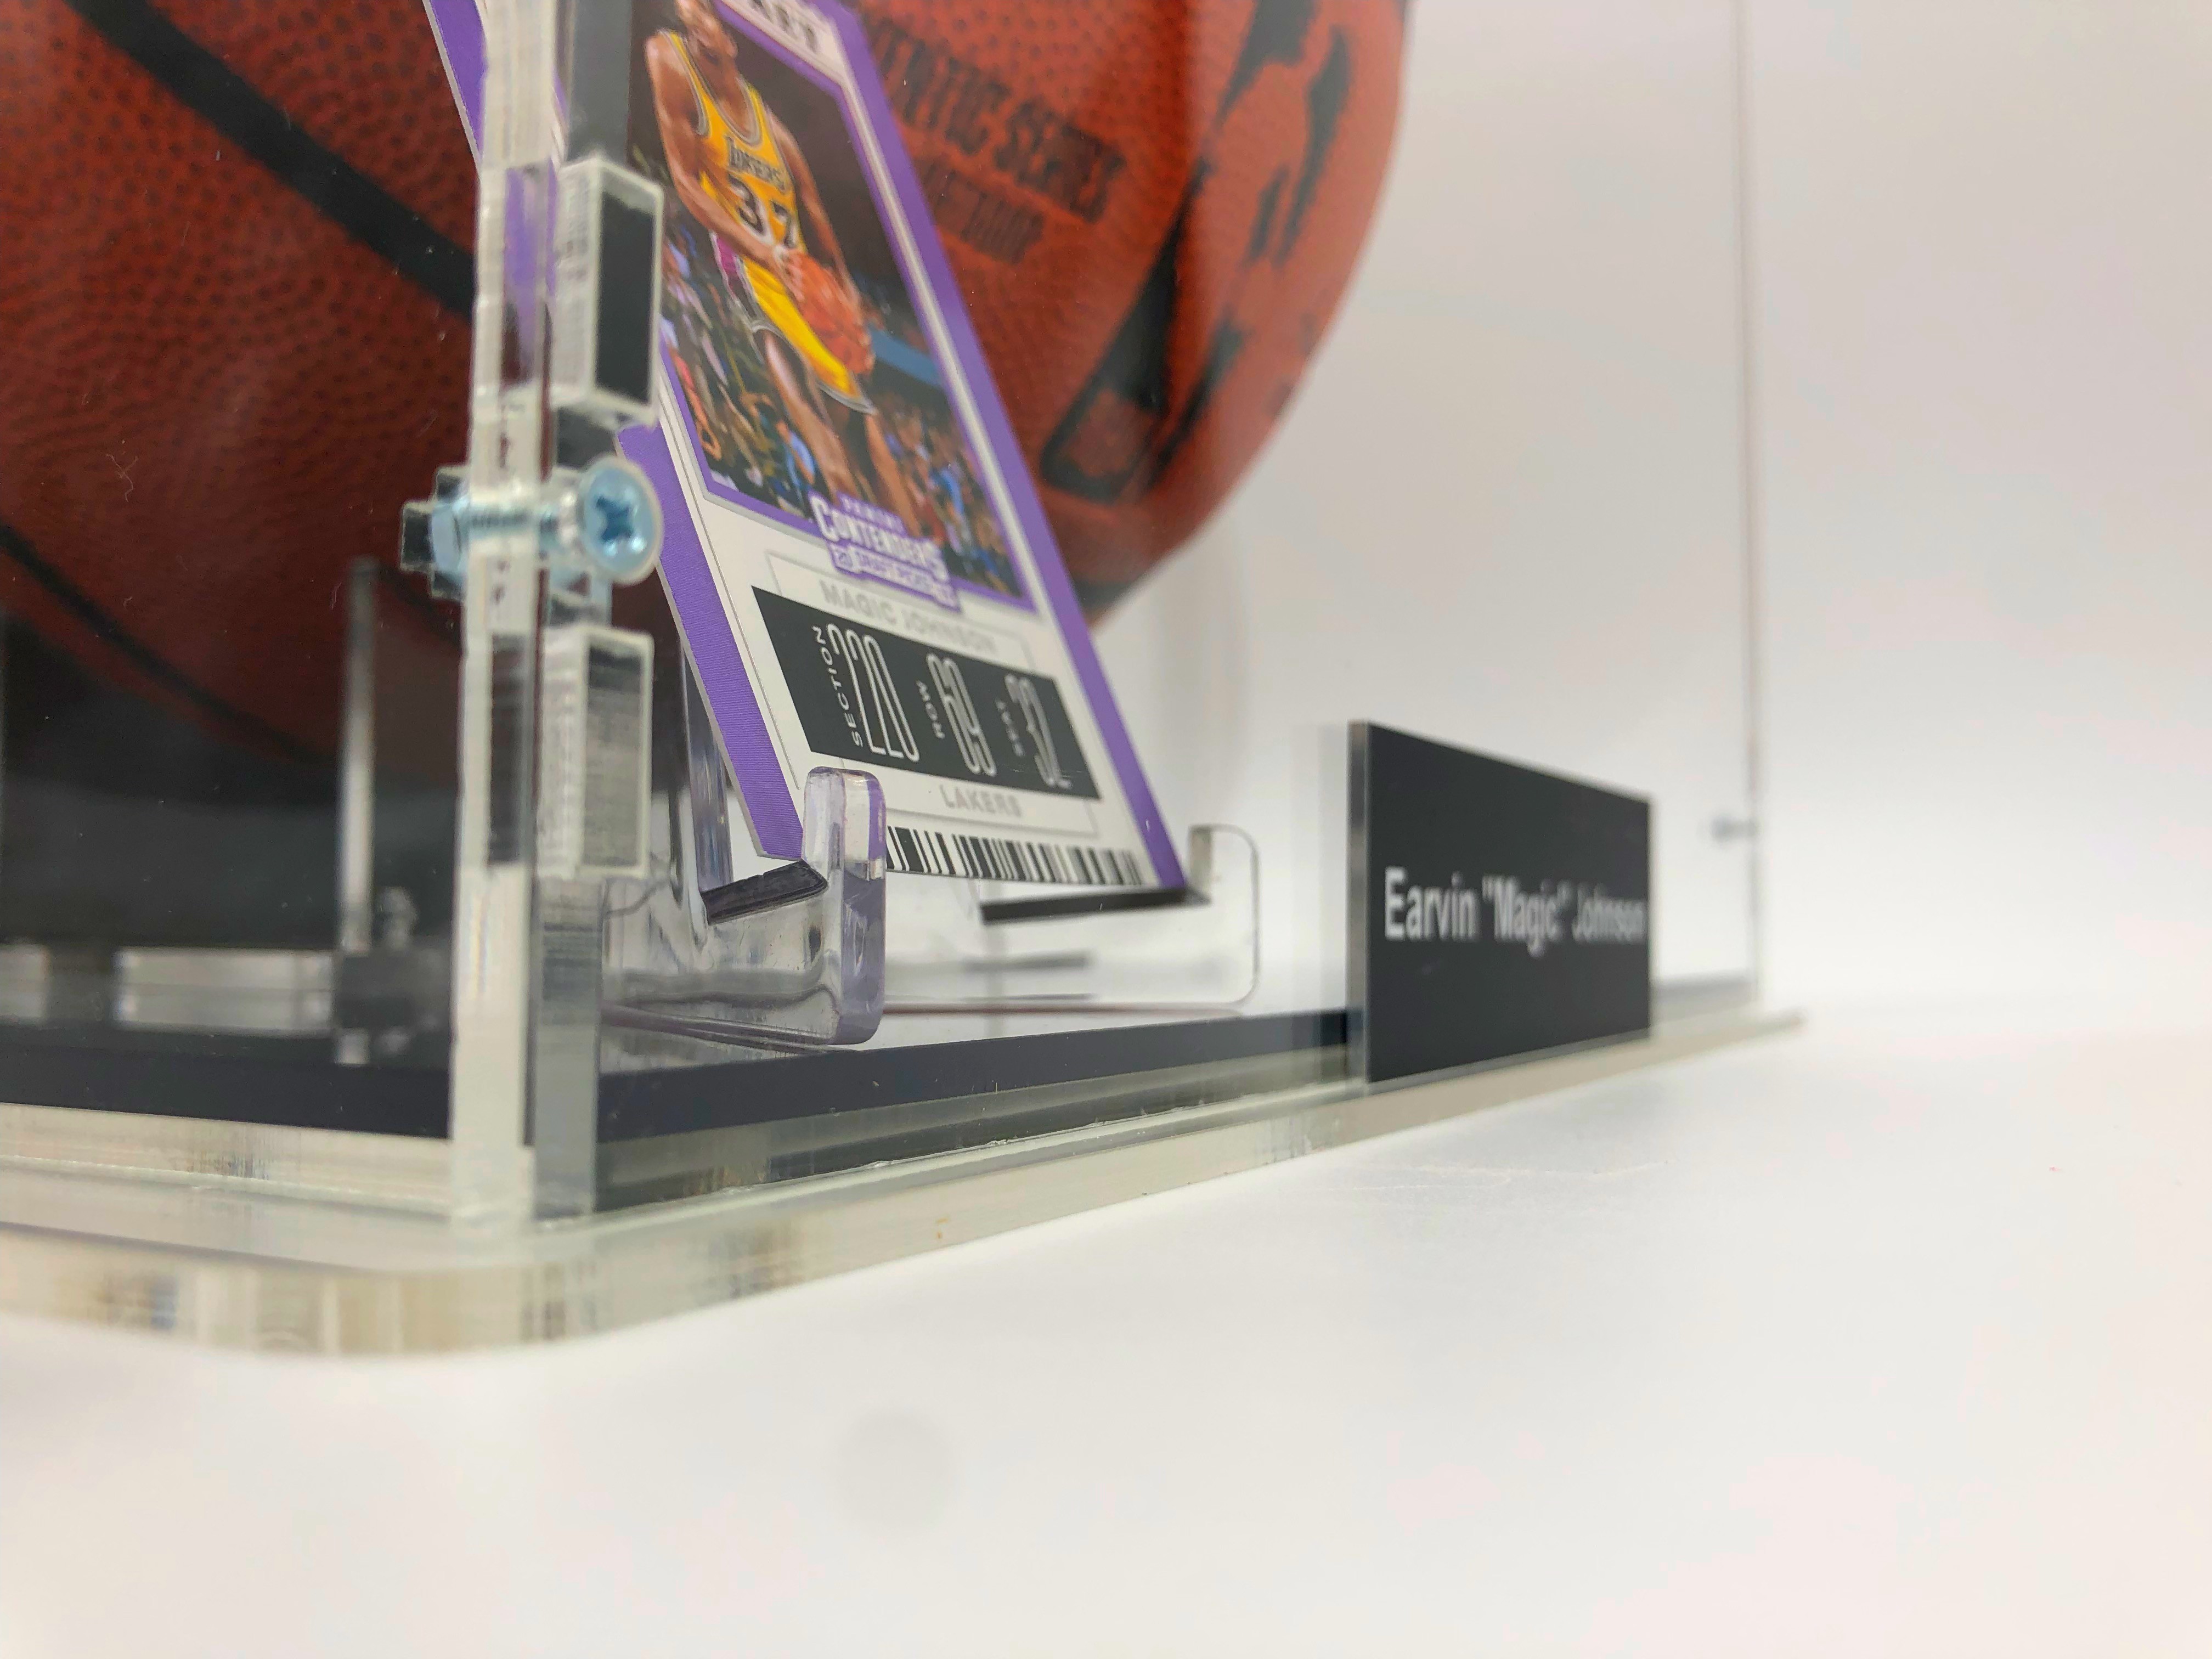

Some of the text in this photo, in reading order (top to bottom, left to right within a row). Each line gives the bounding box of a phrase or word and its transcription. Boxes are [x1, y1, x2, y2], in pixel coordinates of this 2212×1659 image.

[820, 579, 898, 625] MAGIC
[812, 625, 864, 748] SECTION
[827, 623, 921, 763] 220
[939, 785, 1023, 817] LAKERS
[1385, 866, 1478, 941] Earvin
[1572, 881, 1646, 944] Johnson
